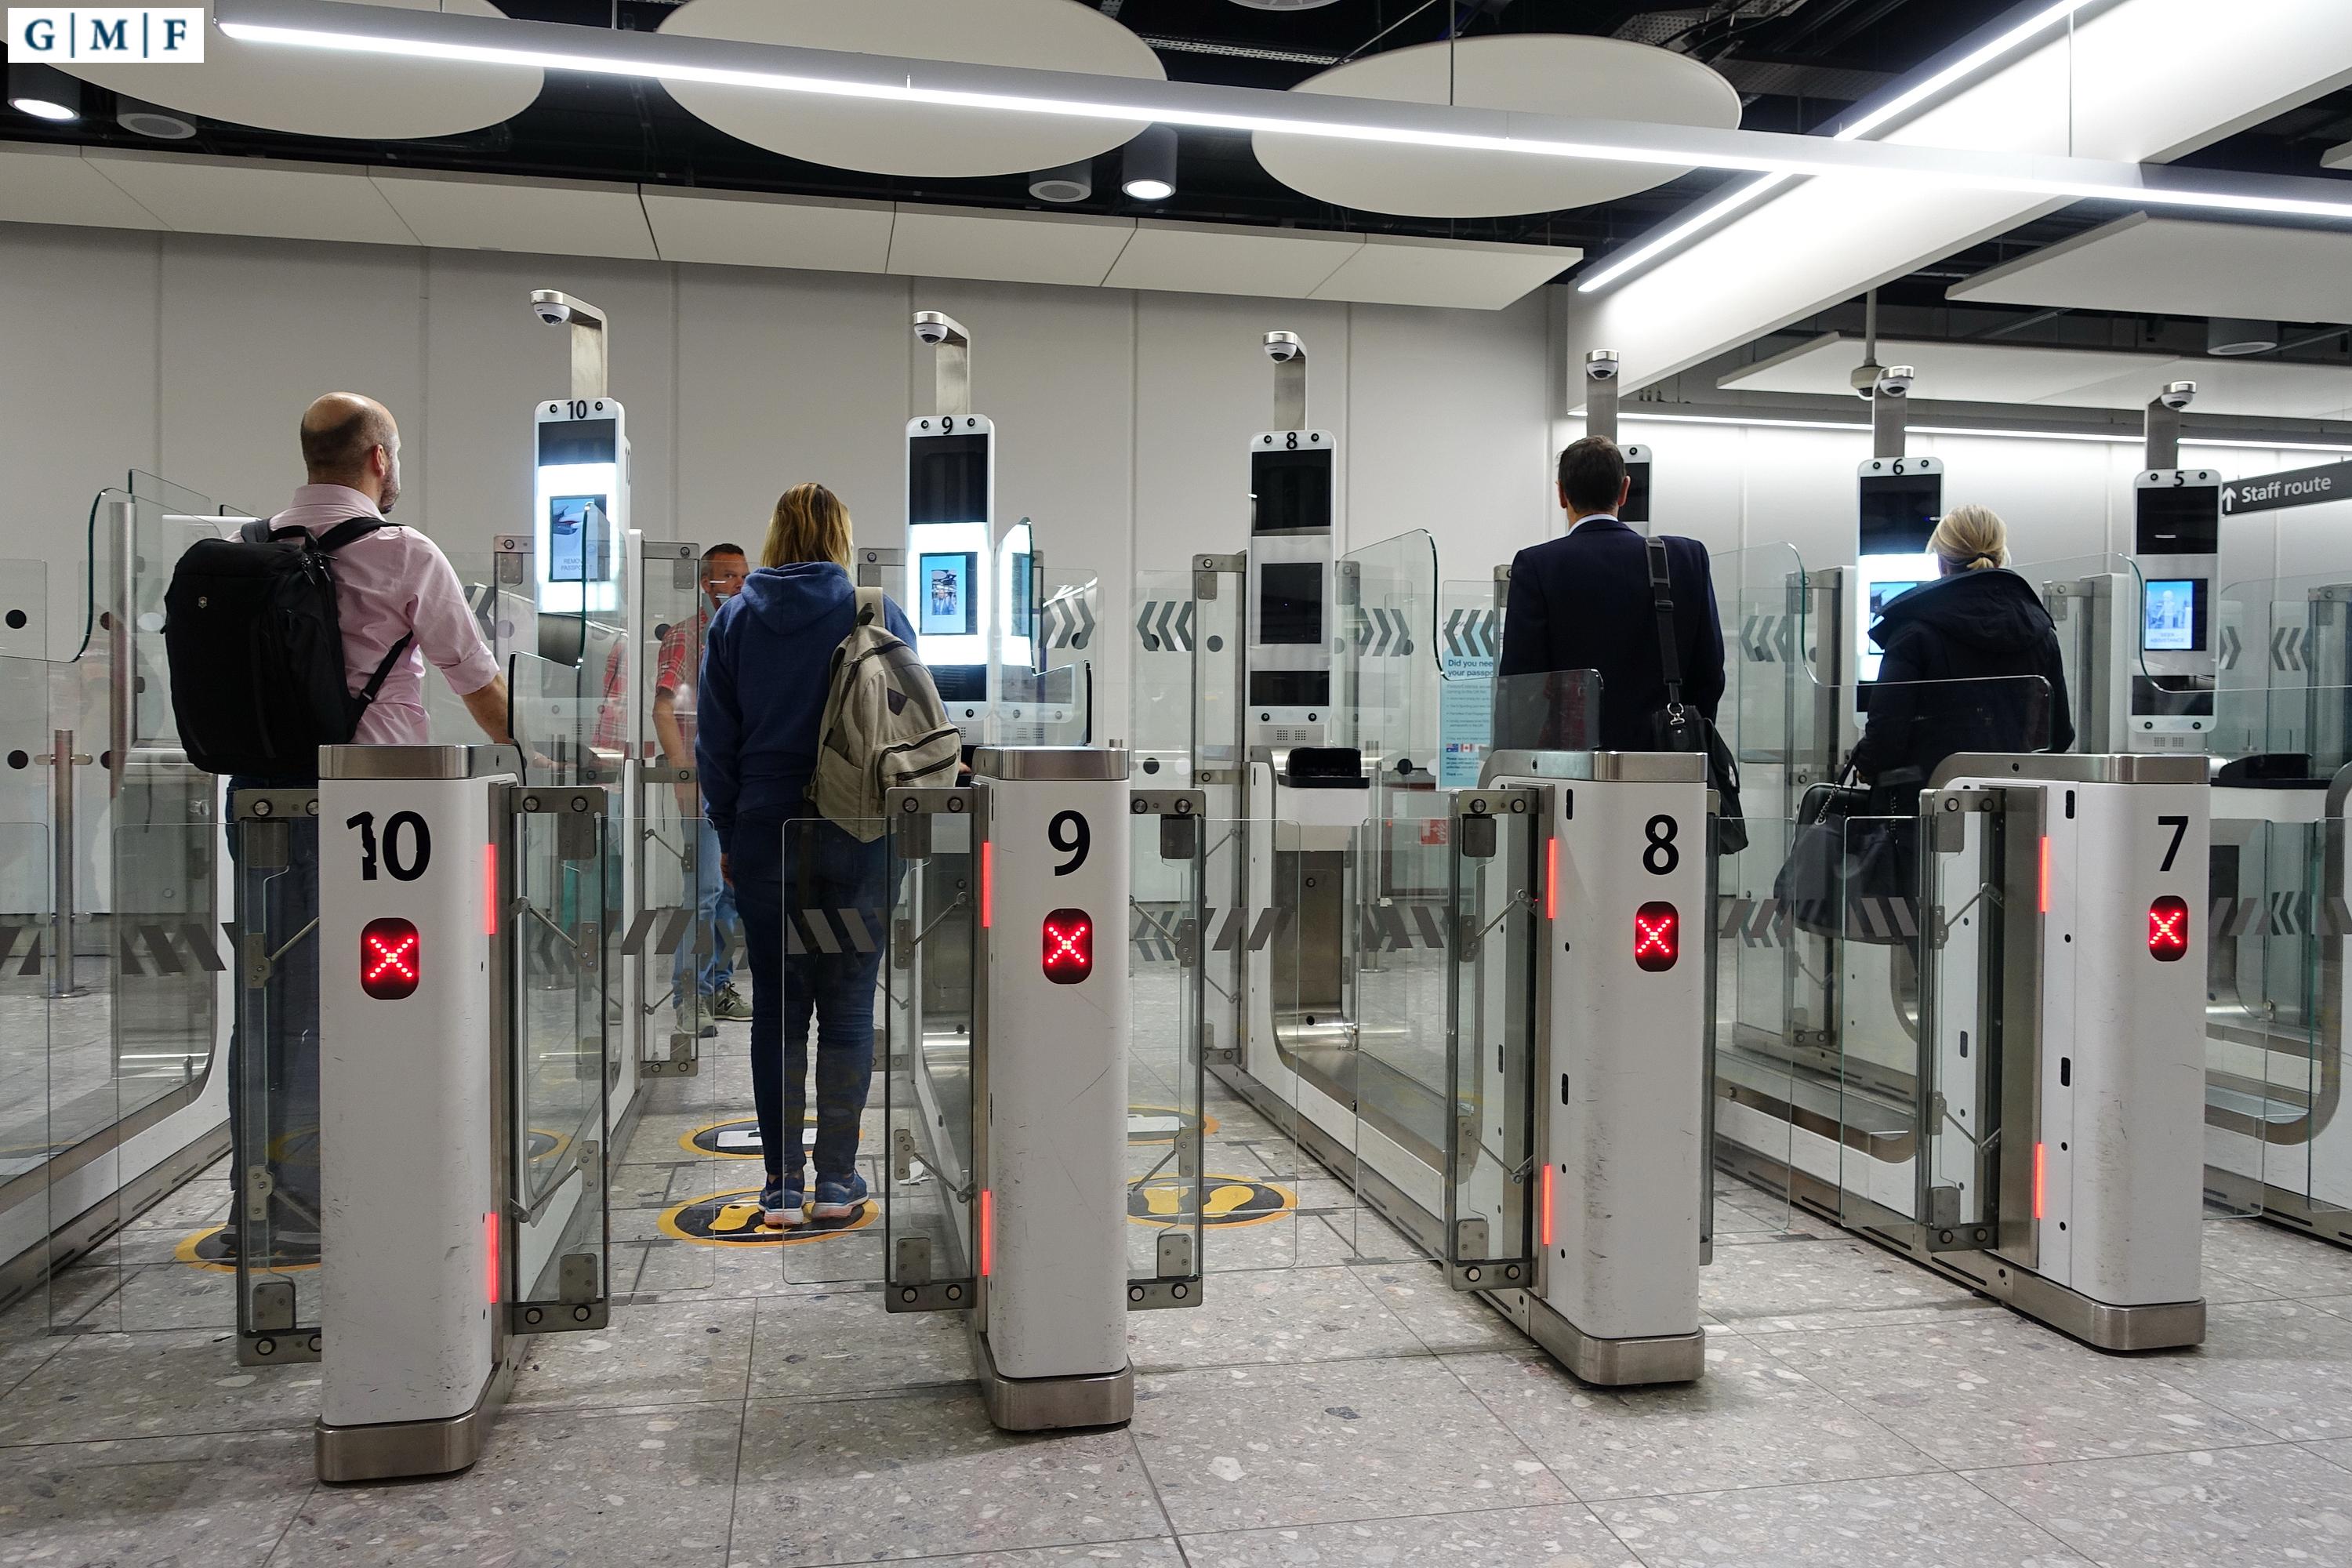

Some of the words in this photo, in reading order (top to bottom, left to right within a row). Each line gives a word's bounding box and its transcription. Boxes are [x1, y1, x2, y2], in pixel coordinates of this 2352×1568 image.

[567, 400, 586, 419] 10
[942, 416, 953, 434] 9
[1287, 432, 1298, 450] 8
[1893, 459, 1904, 475] 6
[2173, 471, 2184, 488] 5
[2241, 481, 2281, 503] Staff
[2284, 476, 2332, 497] route
[347, 811, 430, 881] 10
[1048, 810, 1091, 877] 9
[1643, 815, 1679, 876] 8
[2158, 816, 2189, 872] 7
